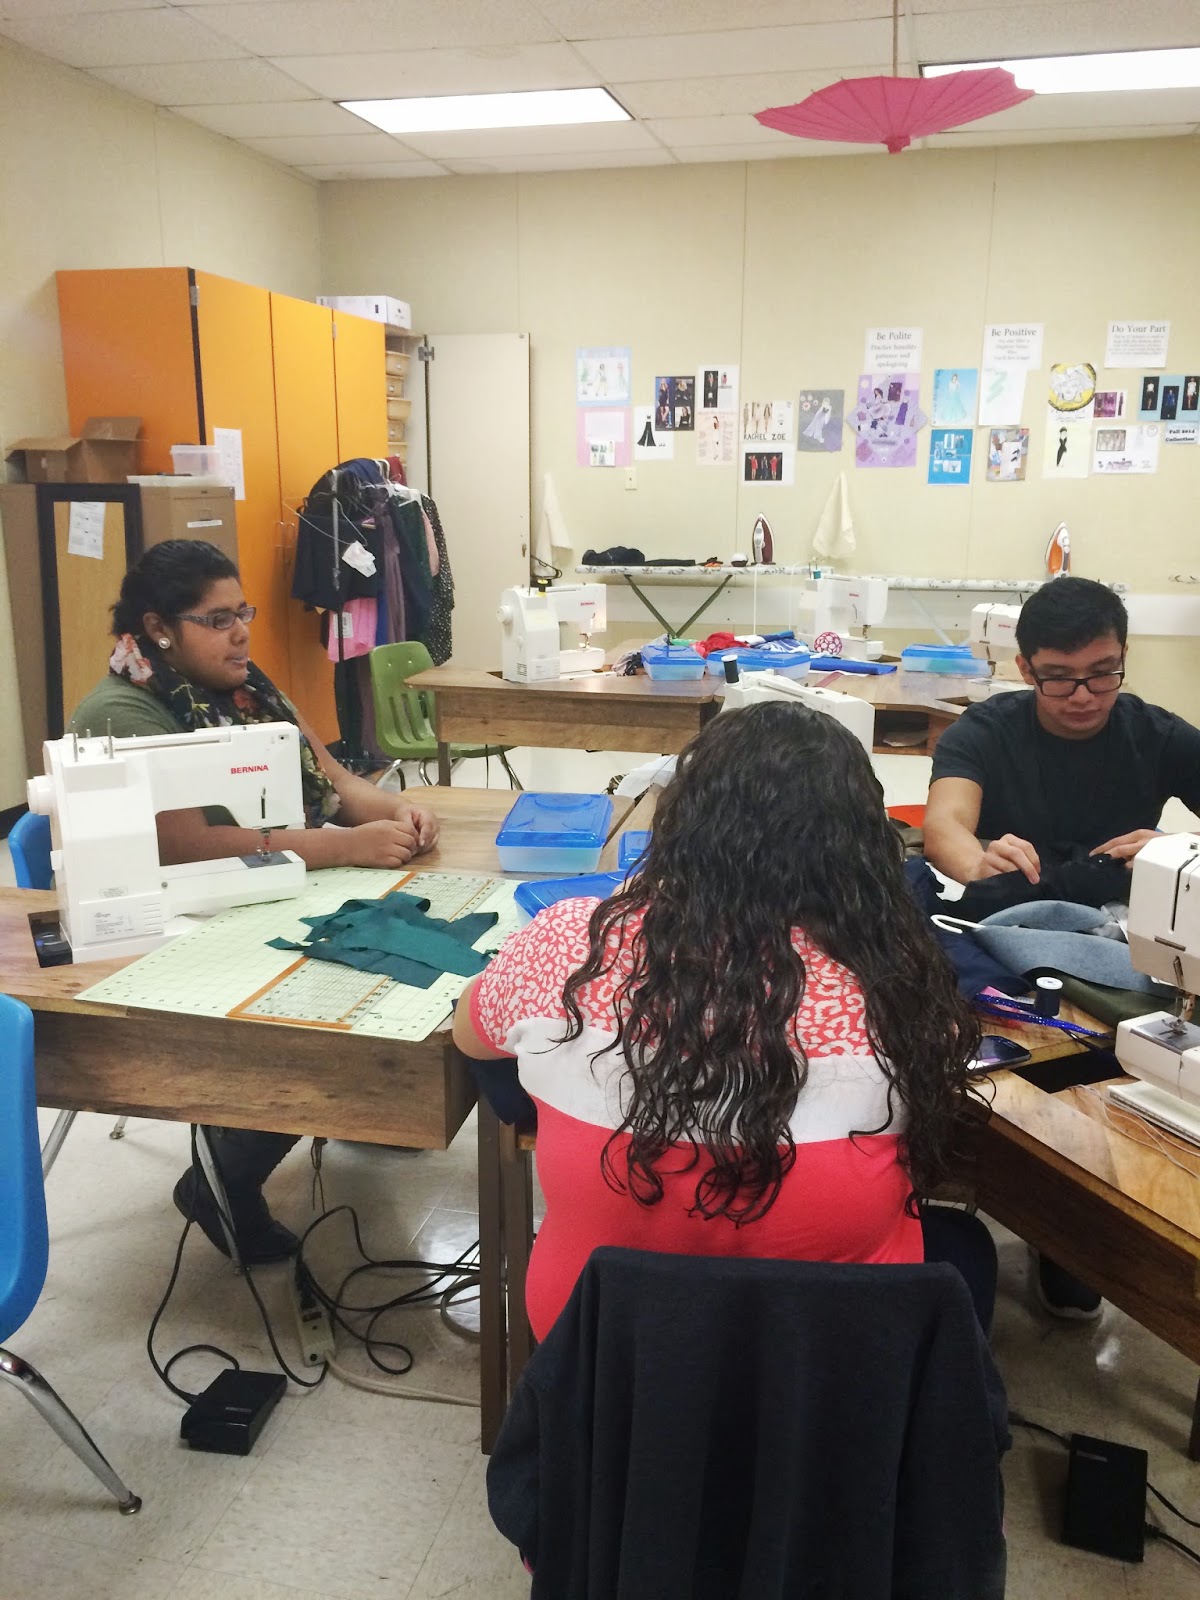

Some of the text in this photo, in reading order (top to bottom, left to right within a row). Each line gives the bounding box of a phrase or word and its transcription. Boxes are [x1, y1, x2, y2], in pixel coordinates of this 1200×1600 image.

[991, 327, 1037, 337] Be Positive
[1111, 324, 1166, 333] Do Your Part
[876, 331, 912, 341] Be Polite
[743, 433, 786, 441] RACHEL ZOE
[230, 764, 269, 775] BERNINA
